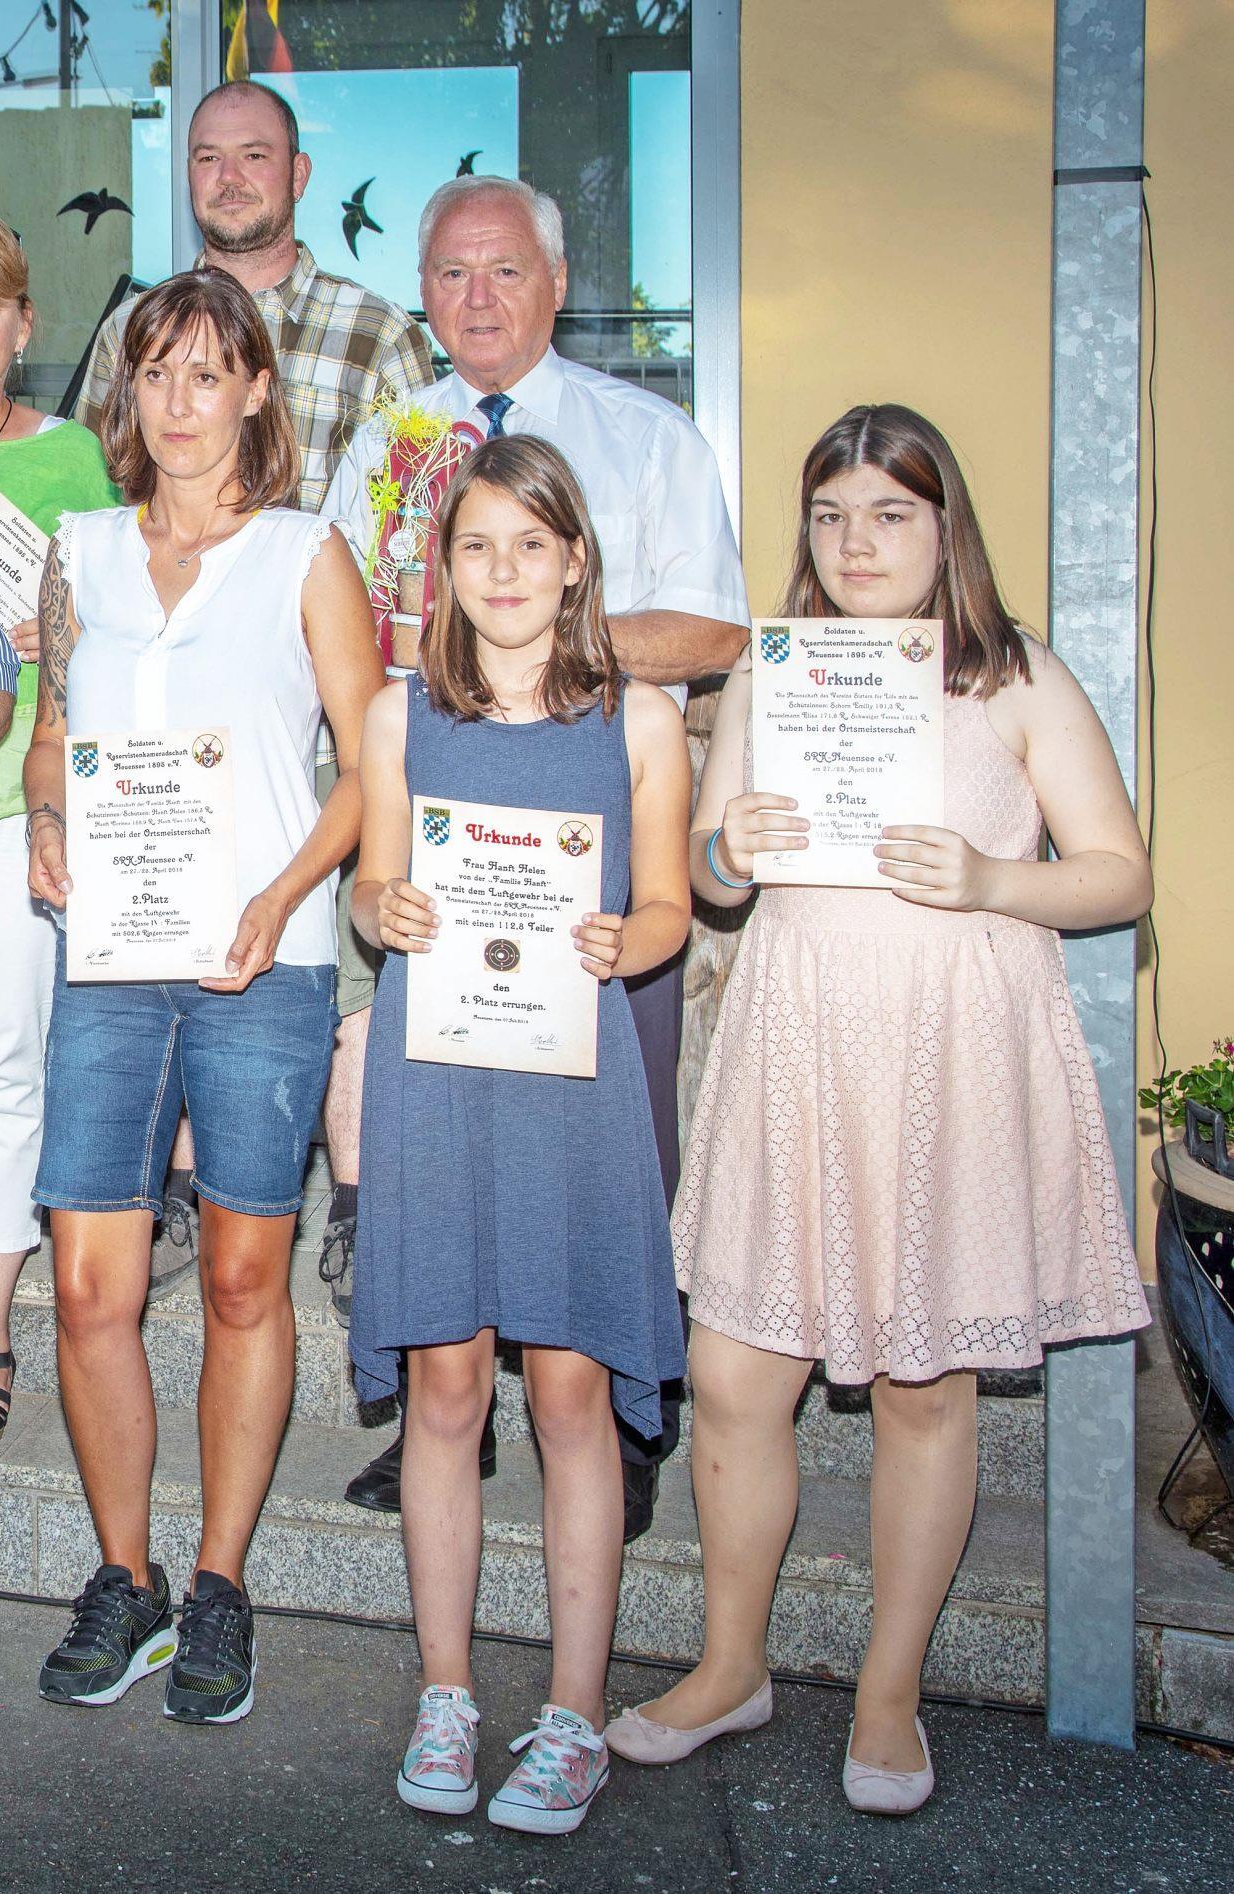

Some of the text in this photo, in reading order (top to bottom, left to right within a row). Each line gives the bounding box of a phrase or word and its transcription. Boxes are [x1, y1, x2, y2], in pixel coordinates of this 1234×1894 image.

[824, 627, 856, 635] Soldaten
[799, 638, 893, 647] Reservistenkameradschaft
[809, 669, 883, 686] Urkunde
[778, 724, 803, 732] haben
[839, 724, 915, 734] Ortsmeisterschaft
[128, 740, 155, 748] Soldaten
[106, 750, 188, 761] Reservistenkameradschaft
[804, 752, 897, 763] SRK-Neuensee e.V.
[114, 763, 145, 771] Neuensee
[168, 759, 181, 768] e.V.
[116, 780, 181, 795] Urkunde
[826, 792, 867, 805] 2.Platz
[839, 810, 879, 819] Luftgewehr
[90, 832, 112, 840] haben
[129, 830, 140, 838] der
[144, 828, 211, 838] Ortsmeisterschaft
[466, 824, 541, 847] Urkunde
[144, 843, 156, 851] der
[113, 853, 195, 866] SRK-Neuensee e.V.
[463, 858, 545, 874] Frau Hanft Helen
[132, 893, 168, 904] 2.Platz
[435, 883, 574, 903] hat mit dem Luftgewehr bei der
[455, 918, 469, 926] mit
[472, 920, 495, 928] einen
[528, 922, 554, 933] Teiler
[493, 983, 509, 992] den
[461, 995, 546, 1011] 2. Platz errungen.
